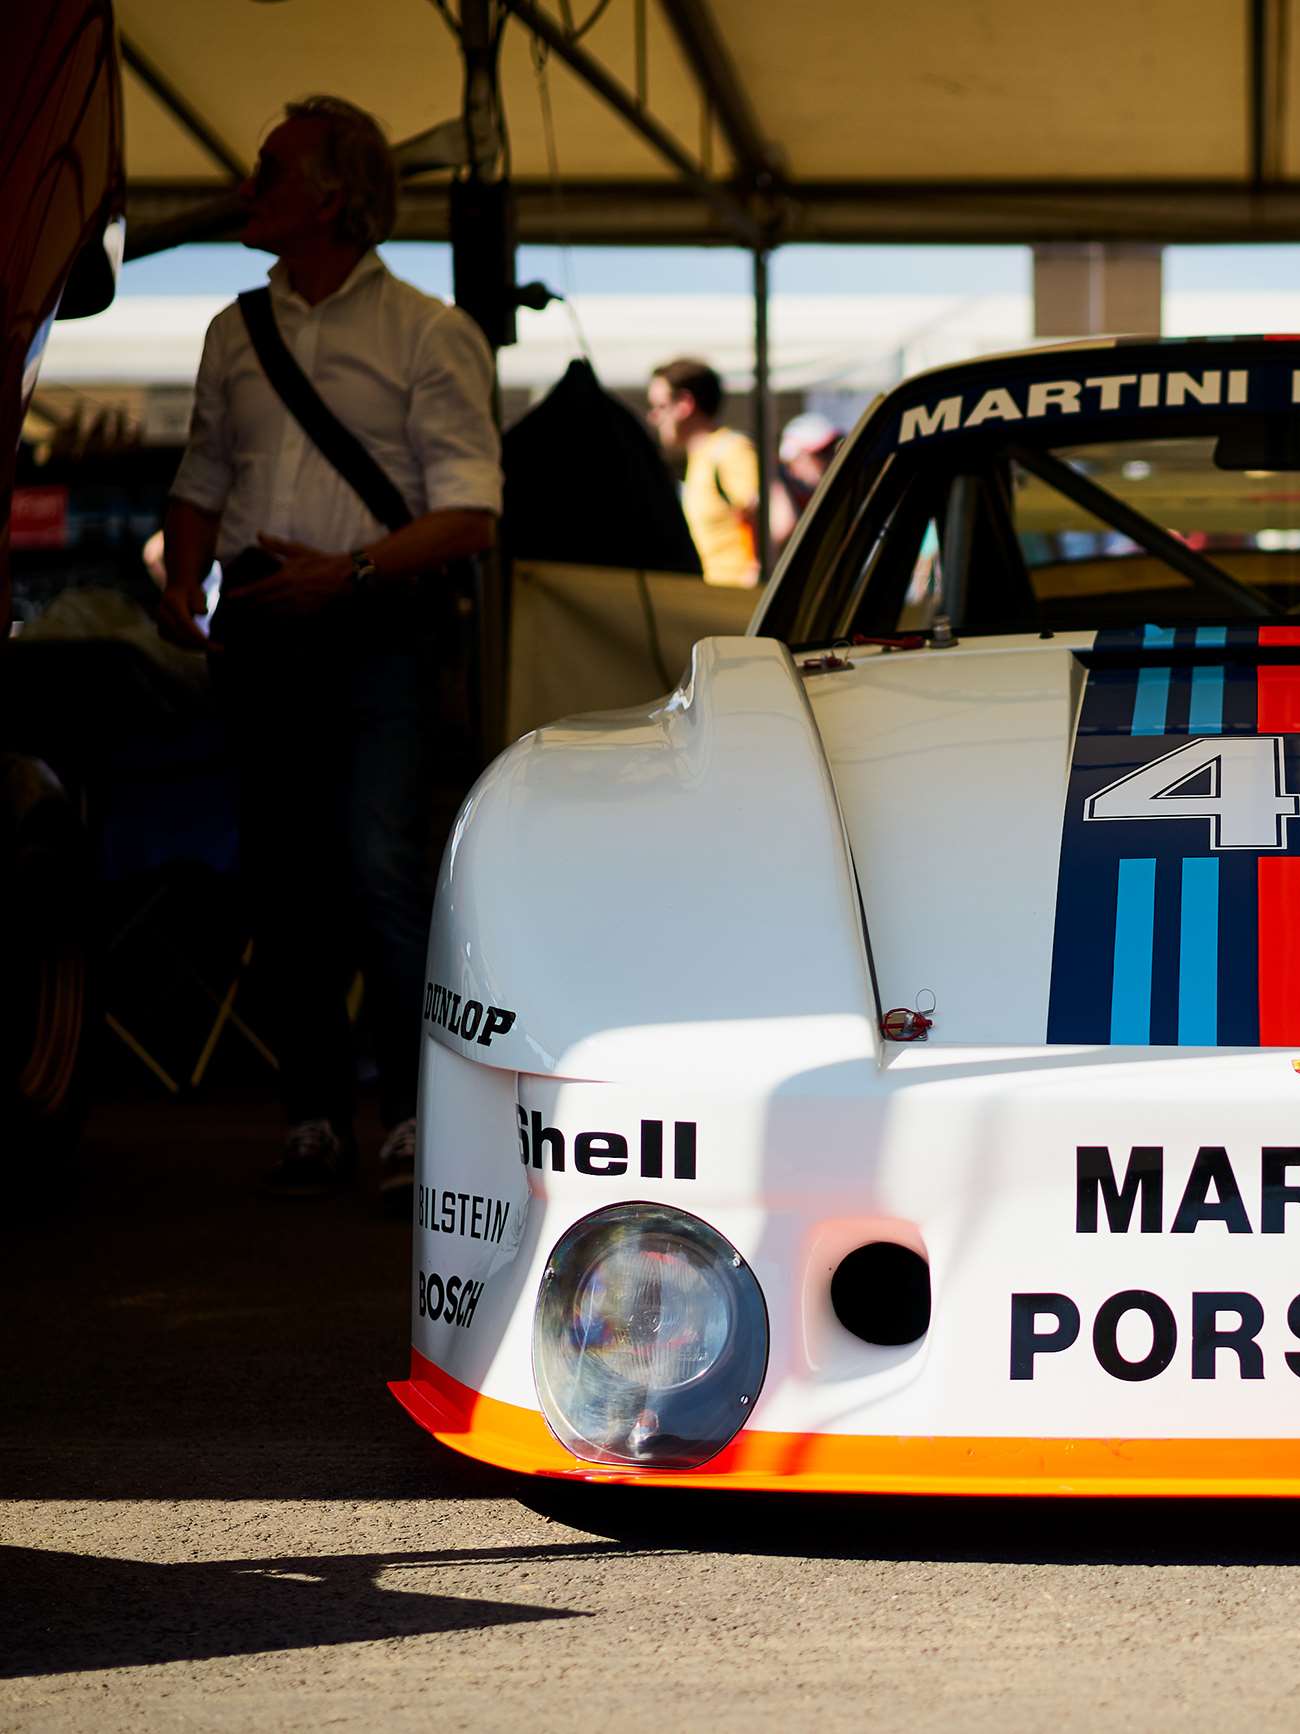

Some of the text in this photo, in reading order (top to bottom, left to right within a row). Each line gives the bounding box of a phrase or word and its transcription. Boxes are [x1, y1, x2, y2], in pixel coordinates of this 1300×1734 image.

[898, 370, 1249, 444] MARTINI
[424, 982, 517, 1047] DUNLOP
[419, 1184, 510, 1243] BILSTEIN
[419, 1270, 485, 1329] BOSCH
